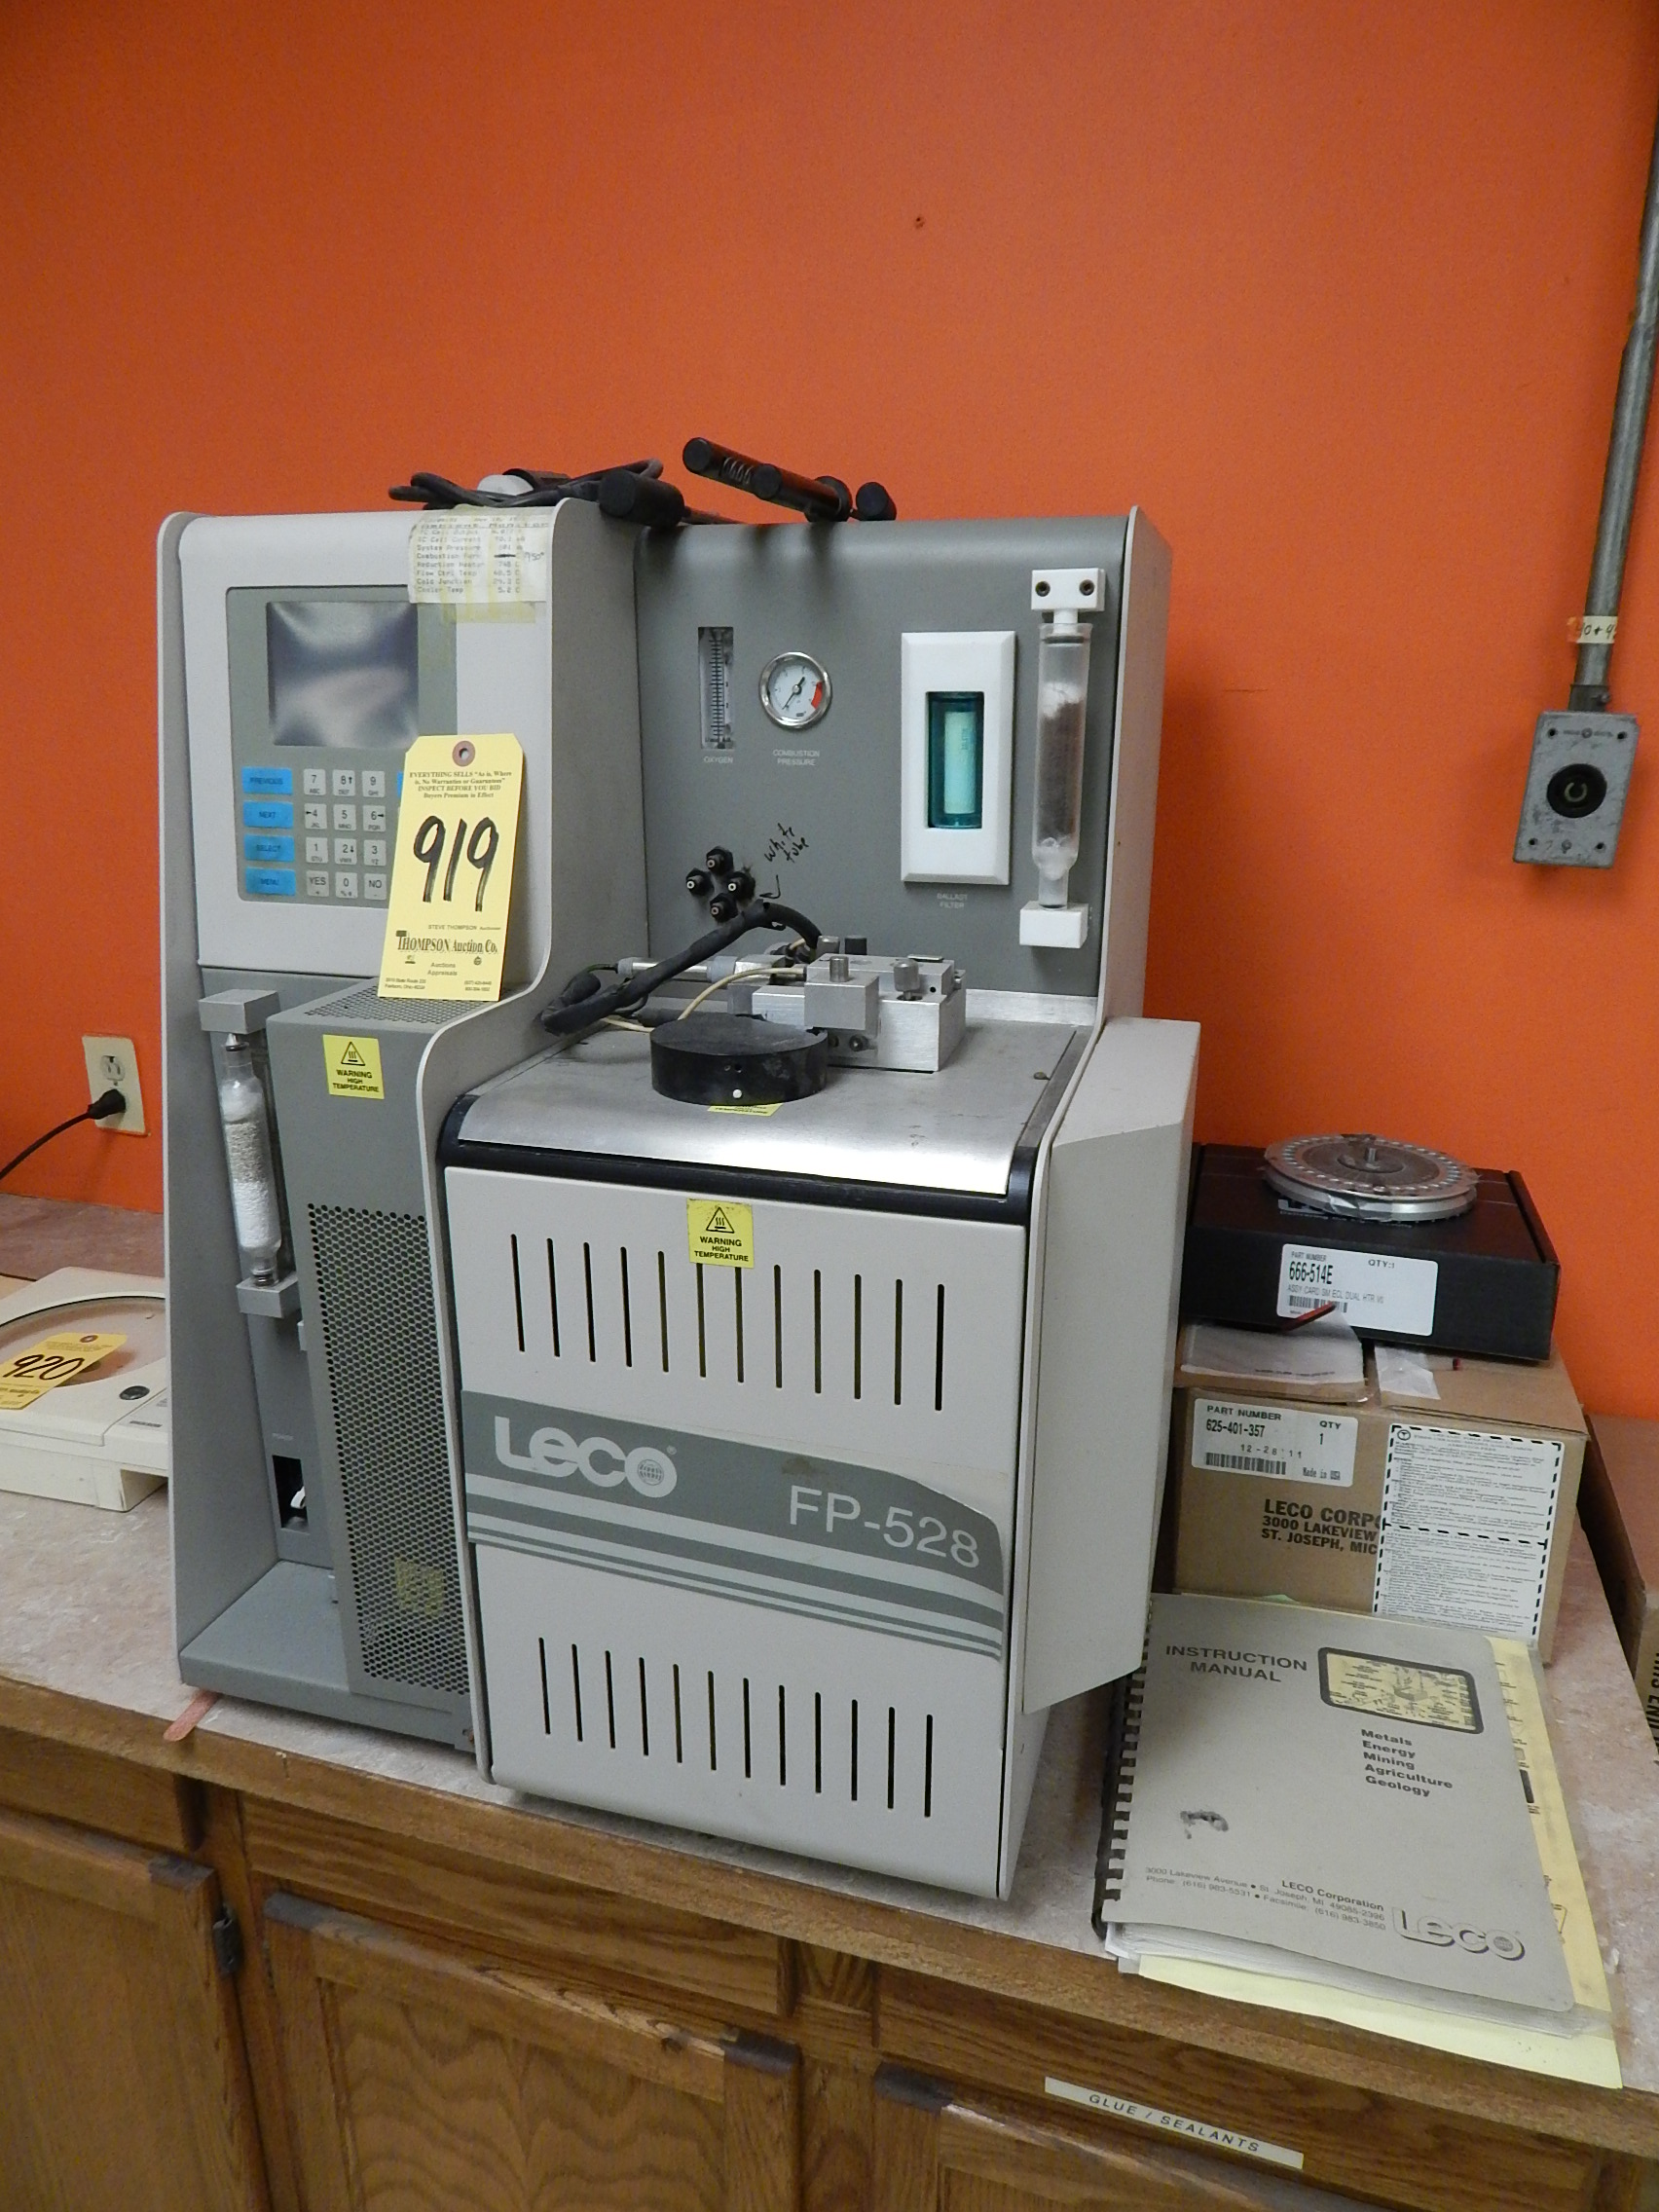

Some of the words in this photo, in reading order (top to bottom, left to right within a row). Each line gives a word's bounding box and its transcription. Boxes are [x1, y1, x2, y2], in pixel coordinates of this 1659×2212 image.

[772, 749, 820, 757] COMBUSTION
[777, 757, 816, 766] PRESSURE
[311, 774, 317, 784] 7
[341, 775, 347, 786] 8
[370, 776, 377, 787] 9
[342, 810, 348, 820] 5
[371, 811, 378, 821] 6
[256, 844, 281, 853] SELECT
[314, 843, 318, 852] 1
[342, 843, 349, 854] 2
[372, 845, 378, 855] 3
[413, 815, 499, 912] 919
[310, 876, 326, 886] YES
[343, 877, 350, 887] 0
[369, 879, 383, 889] NO
[936, 892, 968, 901] BALLAST
[939, 901, 965, 909] FILTER
[395, 930, 451, 952] THOMPSON
[453, 939, 484, 954] Auction
[336, 1069, 373, 1079] WARNING
[332, 1082, 380, 1093] TEMPERATURE
[699, 1235, 743, 1247] WARNING
[693, 1250, 750, 1263] TEMPERATURE
[1306, 1253, 1327, 1263] NUMBER
[1289, 1260, 1334, 1285] 666-514E
[1345, 1290, 1361, 1302] DUAL
[3, 1353, 86, 1381] 920
[1206, 1405, 1234, 1416] PART
[1237, 1409, 1282, 1420] NUMBER
[1319, 1419, 1342, 1430] QTY
[1205, 1418, 1266, 1438] 625-401-357
[1319, 1432, 1324, 1446] 1
[1264, 1498, 1313, 1520] LECO
[790, 1485, 980, 1568] FP-528
[1262, 1515, 1299, 1530] 3000
[1304, 1521, 1377, 1542] LAKEVIEW
[1261, 1528, 1282, 1541] ST.
[1287, 1531, 1345, 1552] JOSEPH,
[1349, 1541, 1378, 1555] MIC
[1165, 1644, 1308, 1672] INSTRUCTION
[1190, 1661, 1282, 1682] MANUAL
[1361, 1728, 1413, 1747] Metals
[1362, 1741, 1417, 1759] Energy
[1362, 1751, 1416, 1771] Mining
[1365, 1763, 1454, 1789] Agriculture
[1365, 1775, 1431, 1798] Geology
[1169, 1868, 1211, 1881] Lakeview
[1213, 1875, 1248, 1889] Avenue
[1281, 1879, 1314, 1894] LECO
[1316, 1888, 1384, 1912] Corporation
[1088, 2093, 1138, 2116] GLUE
[1145, 2111, 1153, 2120] /
[1160, 2116, 1261, 2153] SEALANTS
